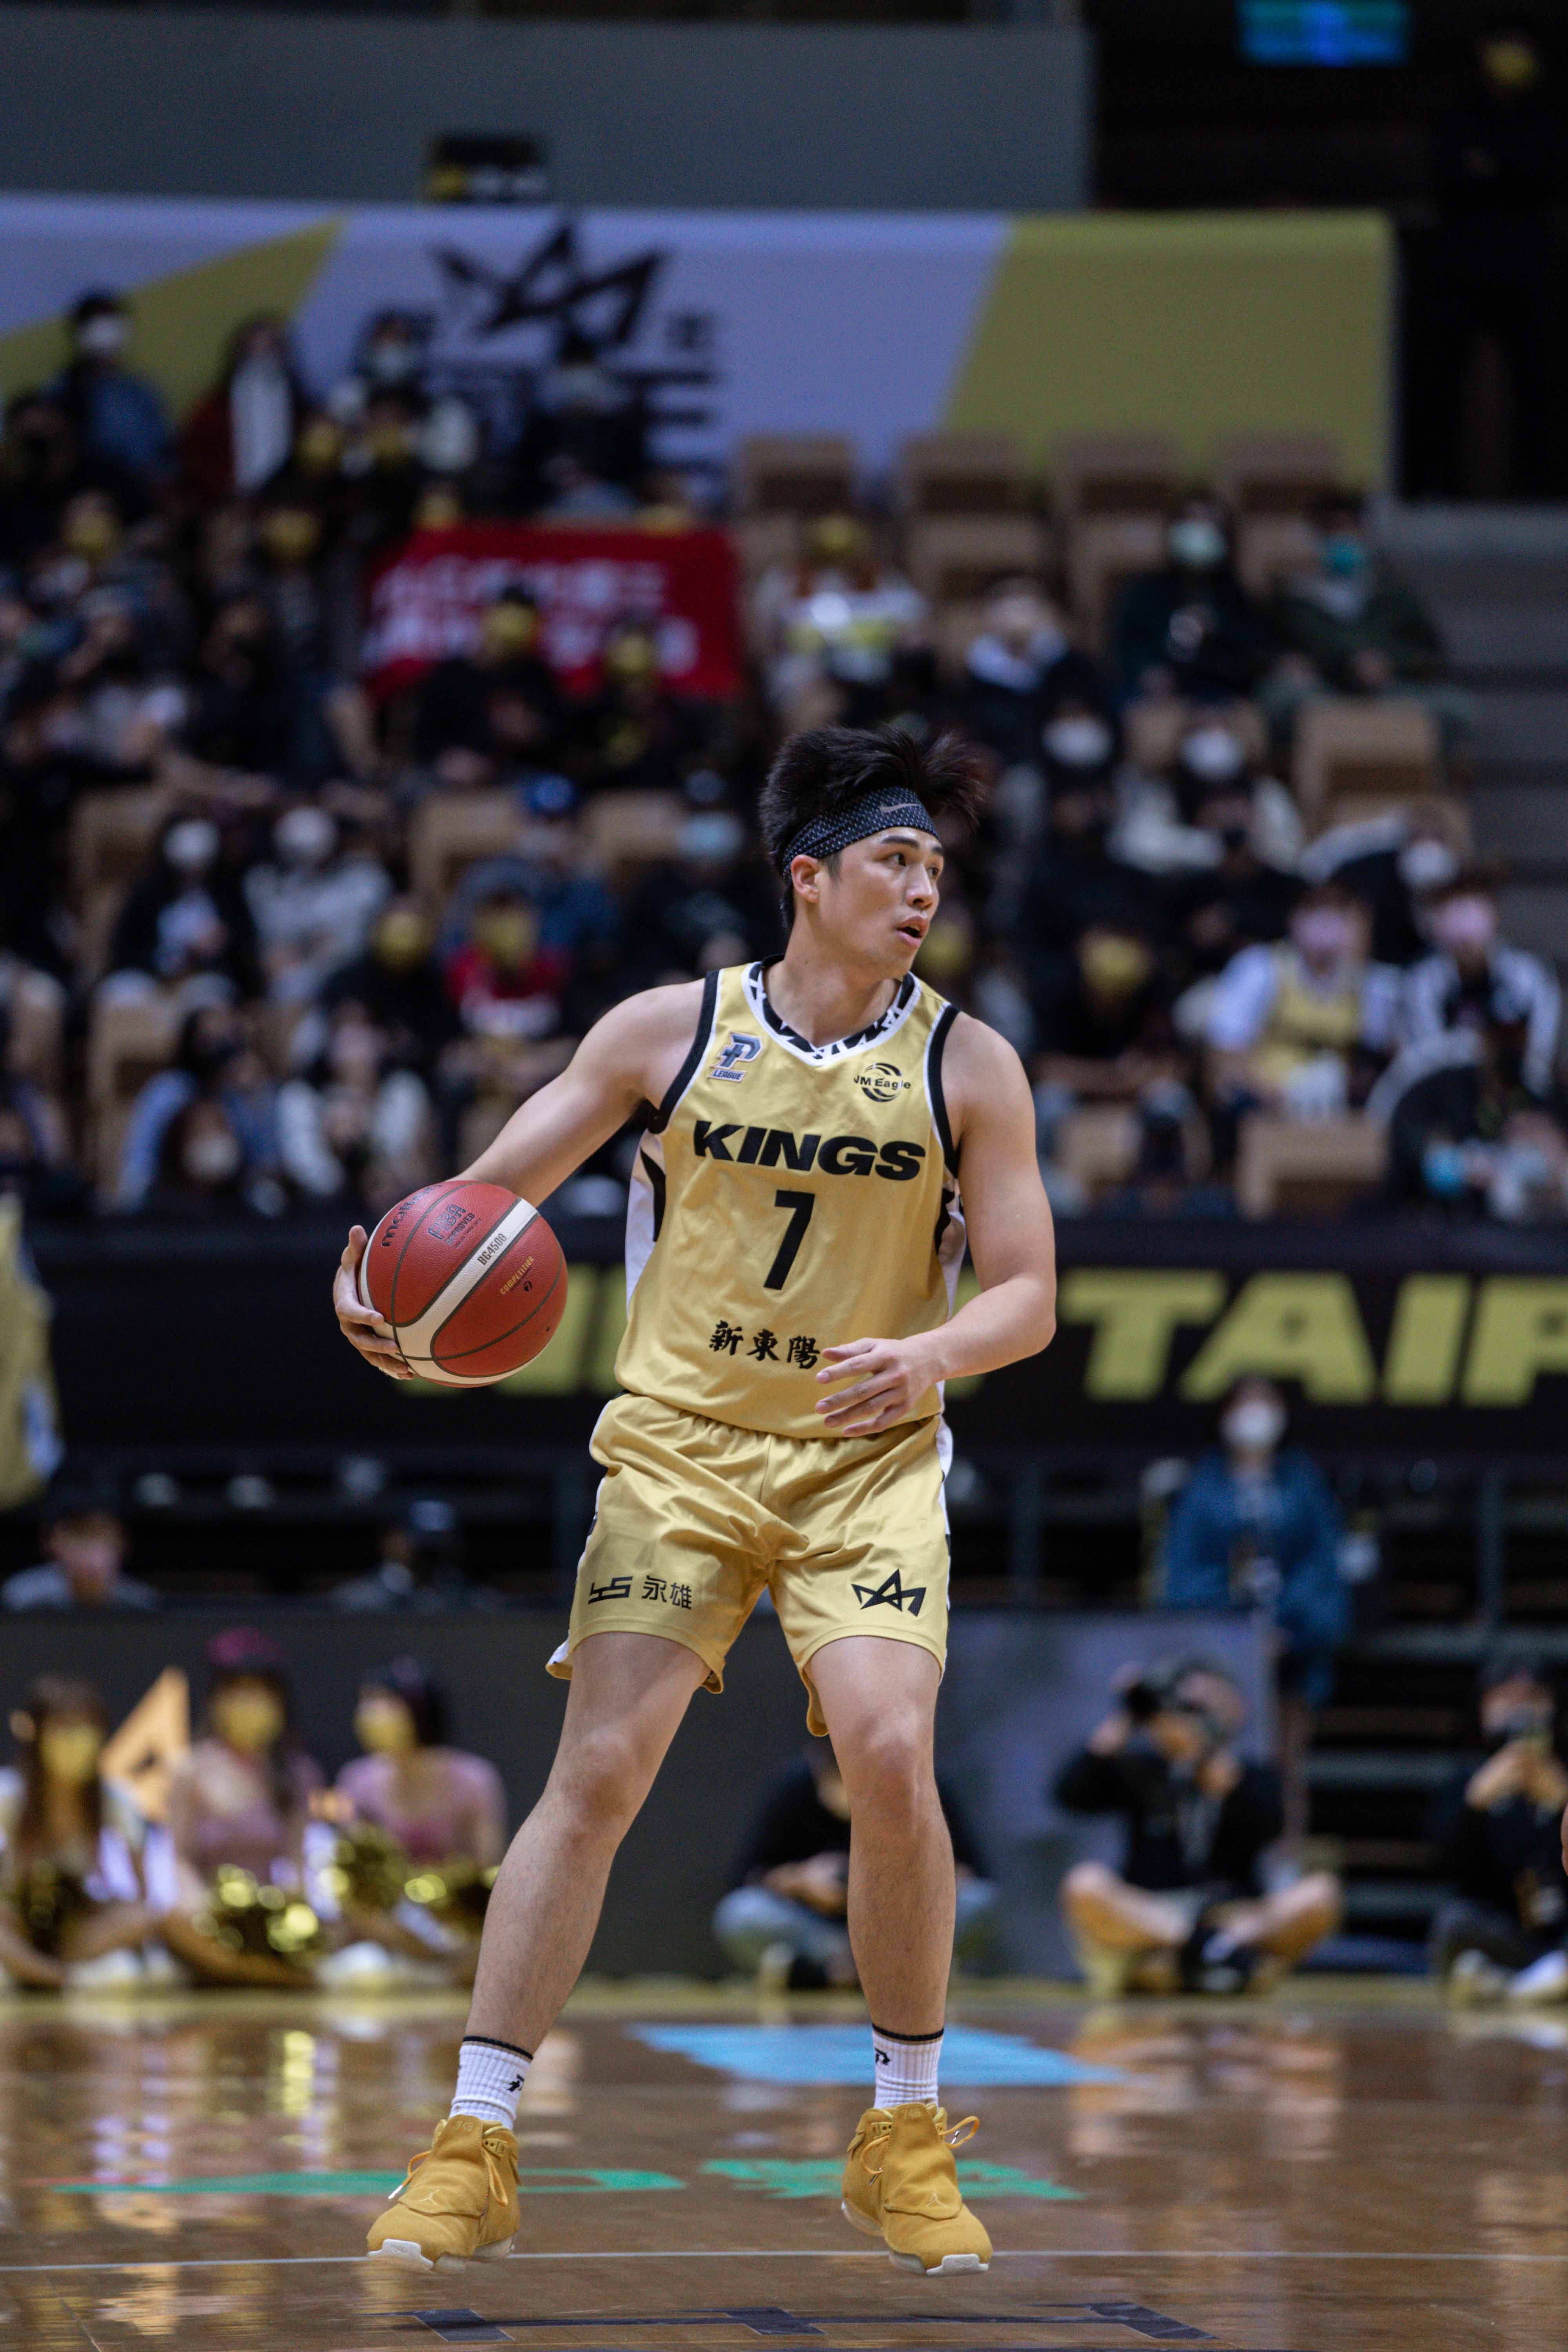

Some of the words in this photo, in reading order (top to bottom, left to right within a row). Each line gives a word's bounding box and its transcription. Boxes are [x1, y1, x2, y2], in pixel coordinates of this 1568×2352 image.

[713, 1069, 743, 1080] LEAGUE
[854, 1075, 871, 1086] JM
[875, 1078, 911, 1091] Eagle
[693, 1120, 926, 1181] KINGS
[428, 1204, 466, 1240] FIBA
[445, 1213, 475, 1246] APPROVED
[763, 1189, 815, 1290] 7
[477, 1233, 507, 1266] BG4500
[709, 1320, 821, 1369] 新東陽
[641, 1575, 691, 1610] 永雄
